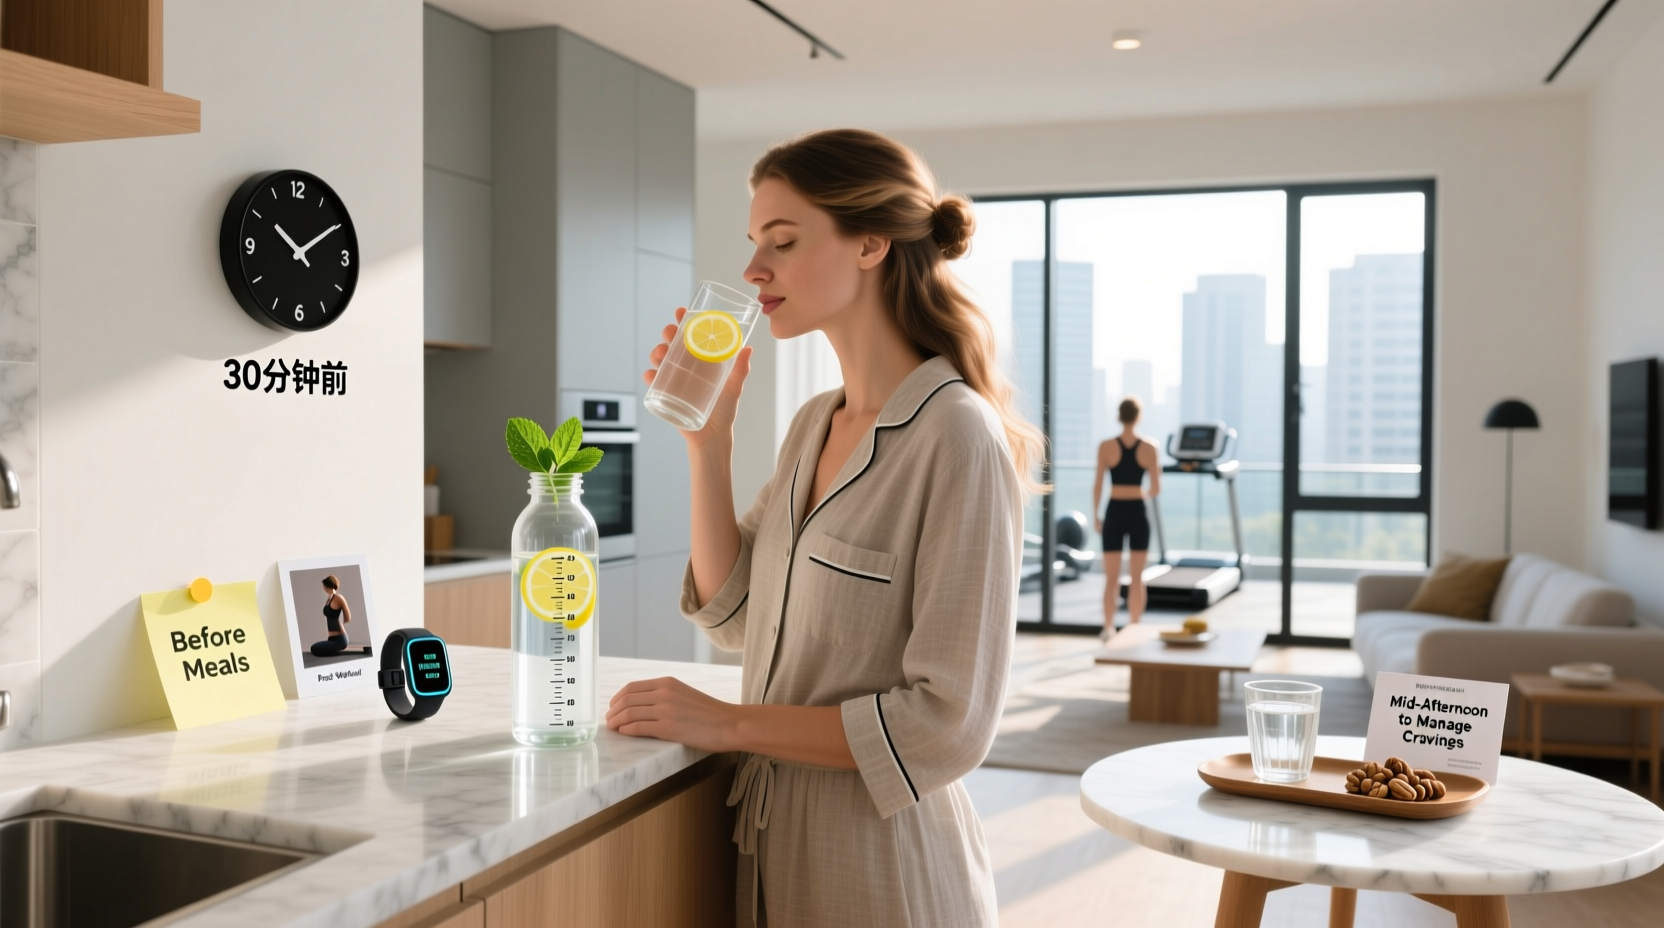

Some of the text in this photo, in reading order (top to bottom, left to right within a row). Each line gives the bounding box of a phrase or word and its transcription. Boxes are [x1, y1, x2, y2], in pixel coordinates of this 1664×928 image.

[290, 180, 306, 199] 12
[245, 237, 256, 255] 9
[340, 250, 350, 267] 3
[294, 304, 305, 321] 6
[223, 358, 348, 396] 30分钟前
[170, 625, 246, 653] Before
[182, 652, 250, 682] Meals
[1390, 695, 1488, 718] Mid-Afternoon
[1398, 713, 1472, 735] to Manage
[1402, 730, 1464, 750] Cravings
